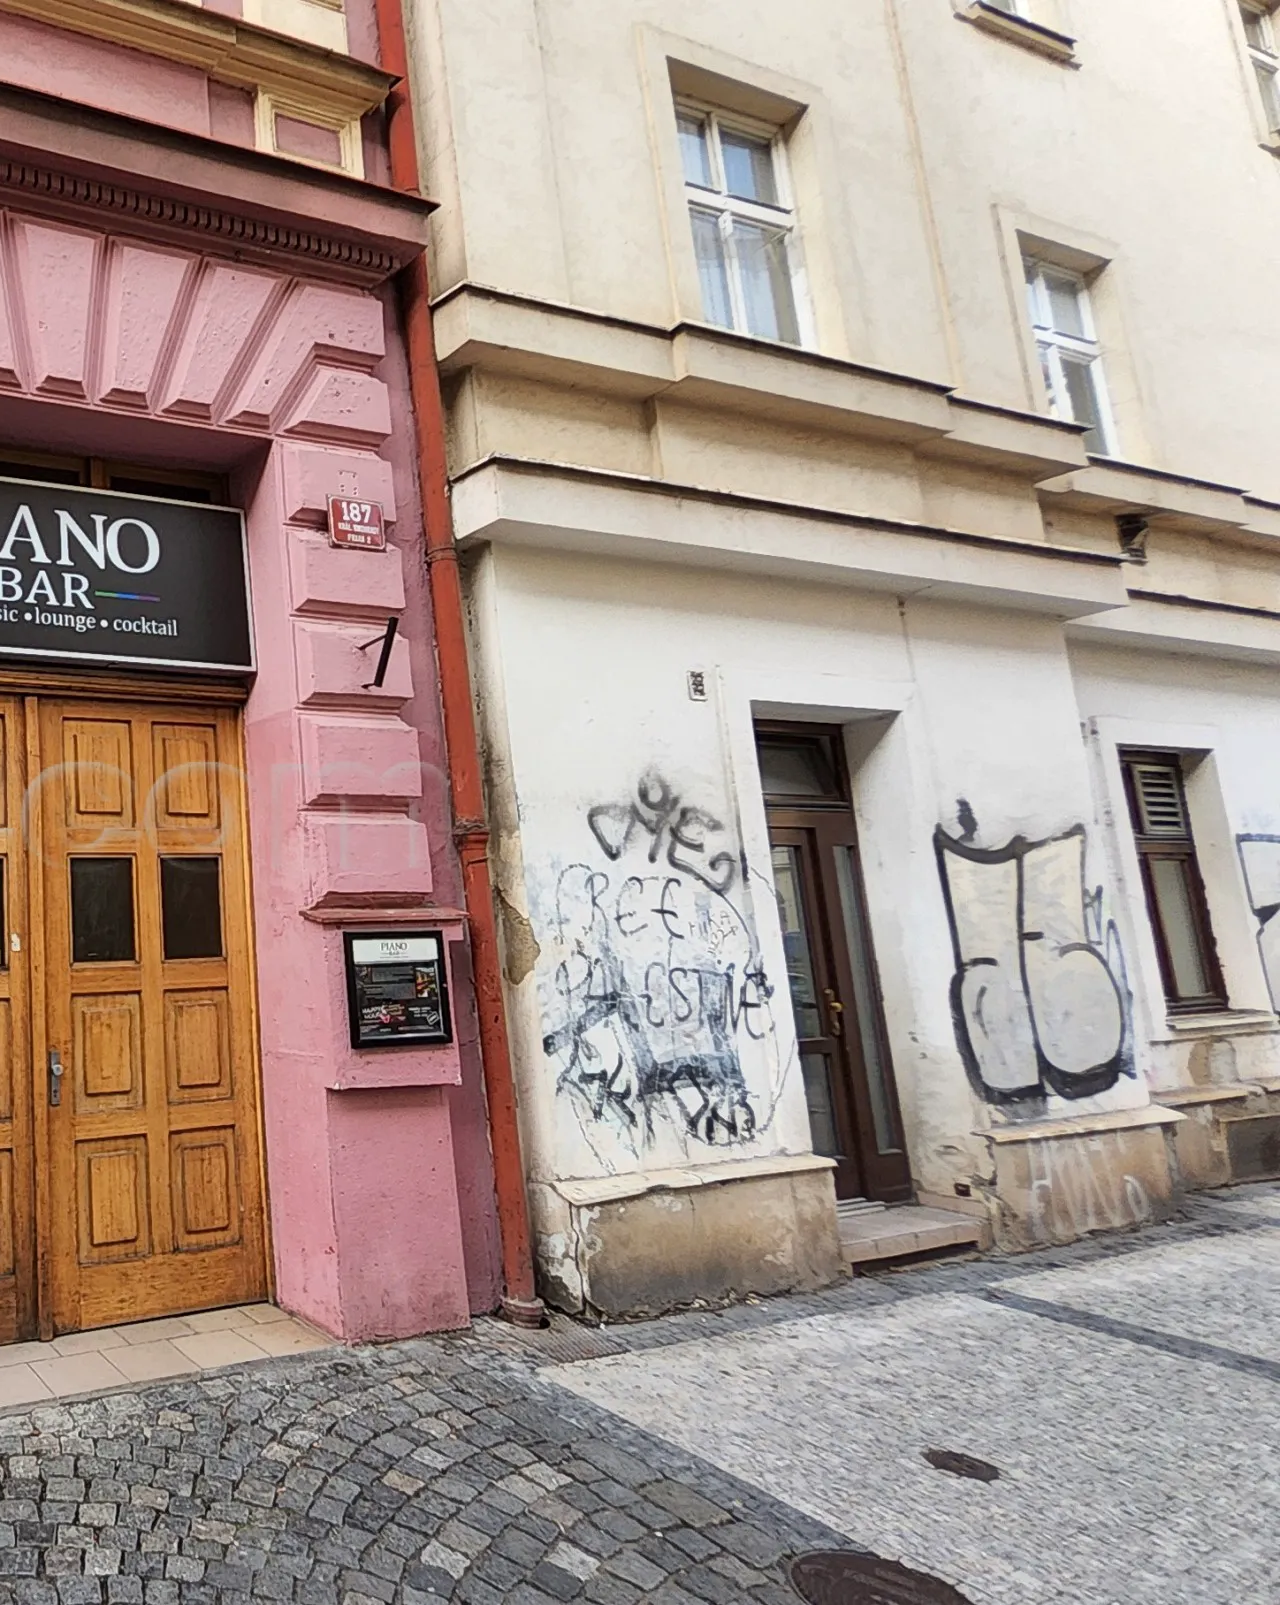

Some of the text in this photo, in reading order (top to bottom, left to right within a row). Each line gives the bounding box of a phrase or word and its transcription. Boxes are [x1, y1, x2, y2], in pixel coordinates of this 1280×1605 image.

[341, 501, 372, 523] 187
[34, 607, 96, 634] lounge
[113, 616, 178, 637] cocktail
[380, 942, 408, 951] PIANO
